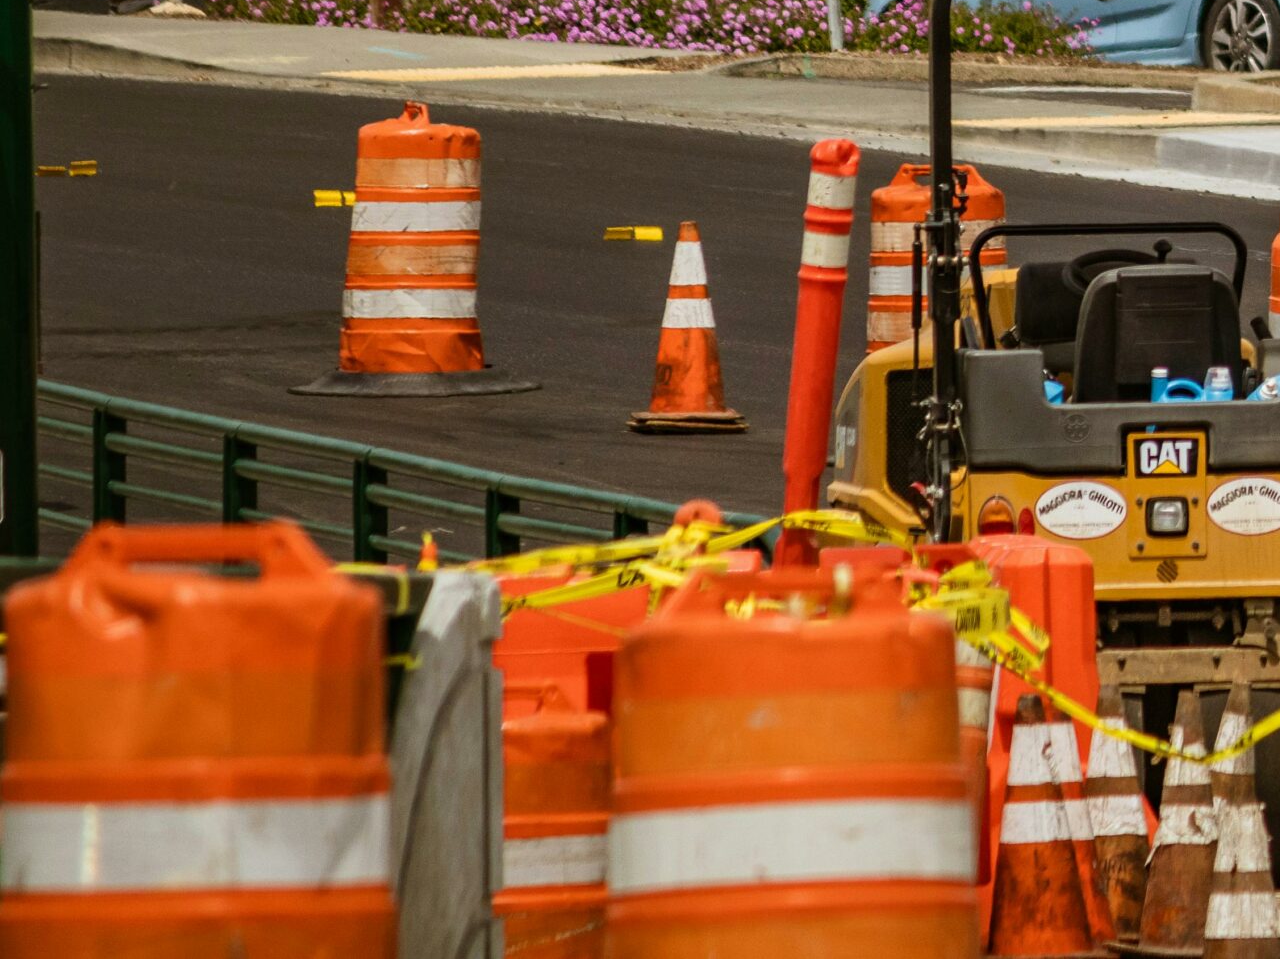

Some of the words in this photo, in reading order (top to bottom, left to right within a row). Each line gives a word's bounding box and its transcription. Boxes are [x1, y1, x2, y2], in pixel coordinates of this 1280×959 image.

[1140, 440, 1192, 474] CAT
[1039, 489, 1083, 516] MAGGIORA
[1088, 490, 1124, 515] GHILOTTI
[1210, 485, 1254, 512] MAGGIORA
